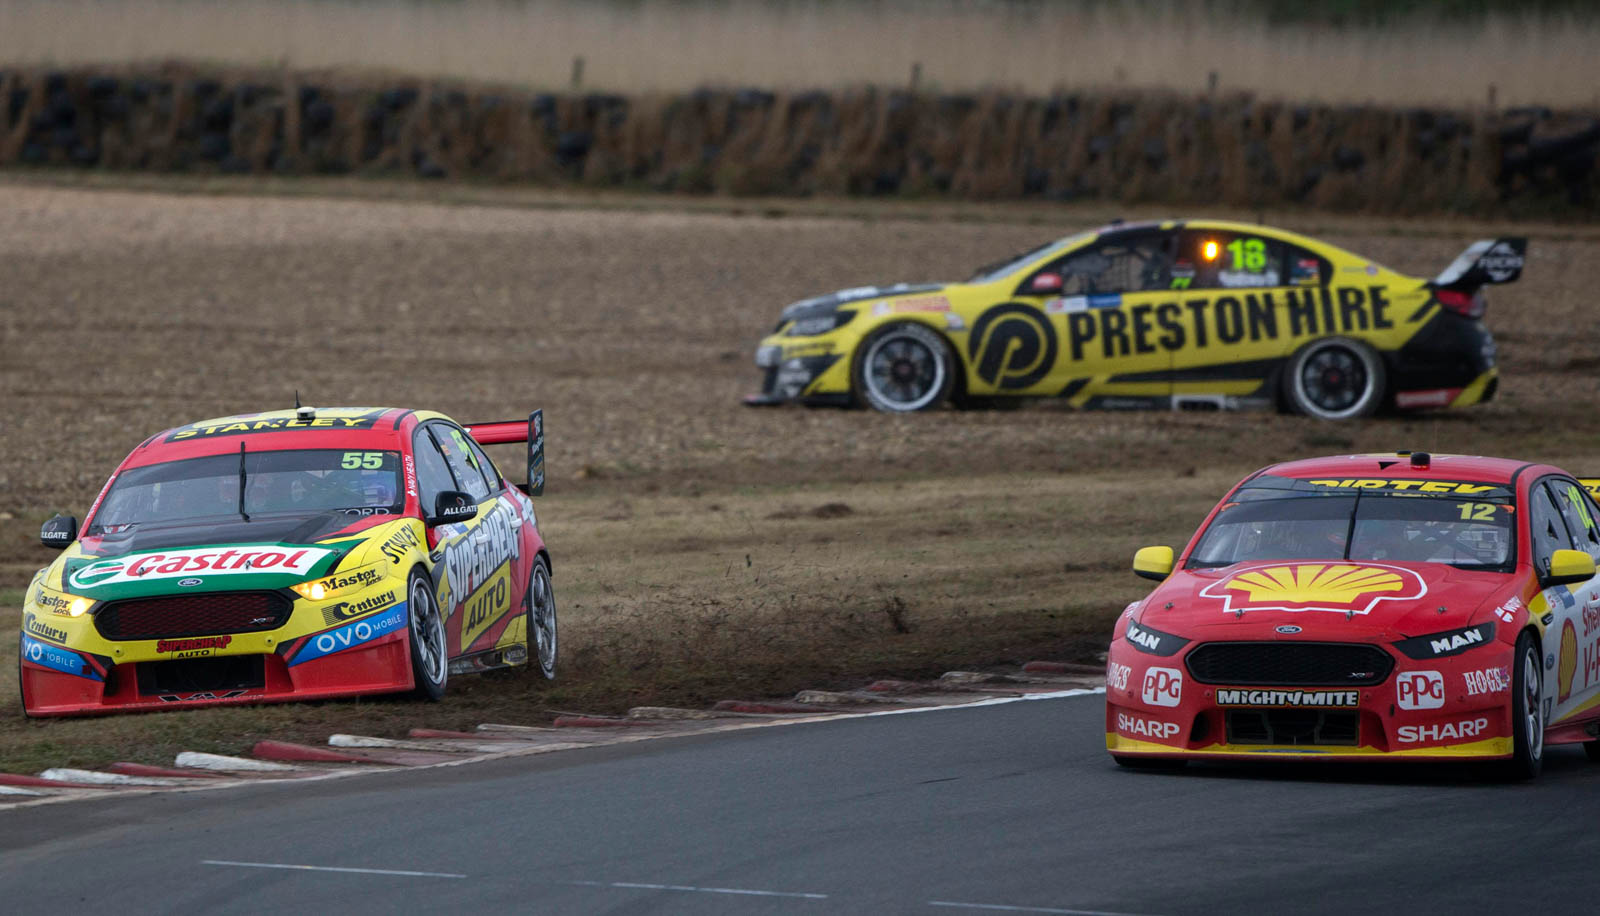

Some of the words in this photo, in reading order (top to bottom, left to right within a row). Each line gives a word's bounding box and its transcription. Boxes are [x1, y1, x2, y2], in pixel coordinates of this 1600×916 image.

[1226, 238, 1267, 272] 18
[1067, 292, 1279, 361] PRESTON
[1286, 285, 1394, 338] HIRE
[174, 418, 368, 440] STANLEY
[341, 451, 383, 470] 55
[336, 507, 390, 516] ORD
[1456, 502, 1497, 521] 12
[40, 531, 68, 540] LLGATE
[381, 523, 420, 564] STANLEY
[126, 550, 309, 577] Castrol
[444, 497, 520, 616] SUPERCHEAP
[320, 568, 377, 592] Master
[333, 590, 396, 621] Century
[465, 576, 506, 636] AUTO
[24, 611, 68, 643] Century
[316, 622, 373, 653] OVO
[373, 613, 402, 632] MOBILE
[1127, 625, 1160, 650] MAN
[22, 643, 42, 661] VO
[156, 634, 232, 654] SUPERCHEAP
[177, 649, 210, 658] AUTO
[1430, 628, 1484, 654] MAN
[1144, 670, 1180, 702] PPG
[1399, 674, 1443, 706] PPG
[1462, 667, 1503, 696] HOGS
[1118, 712, 1180, 739] SHARP
[1398, 717, 1488, 743] SHARP
